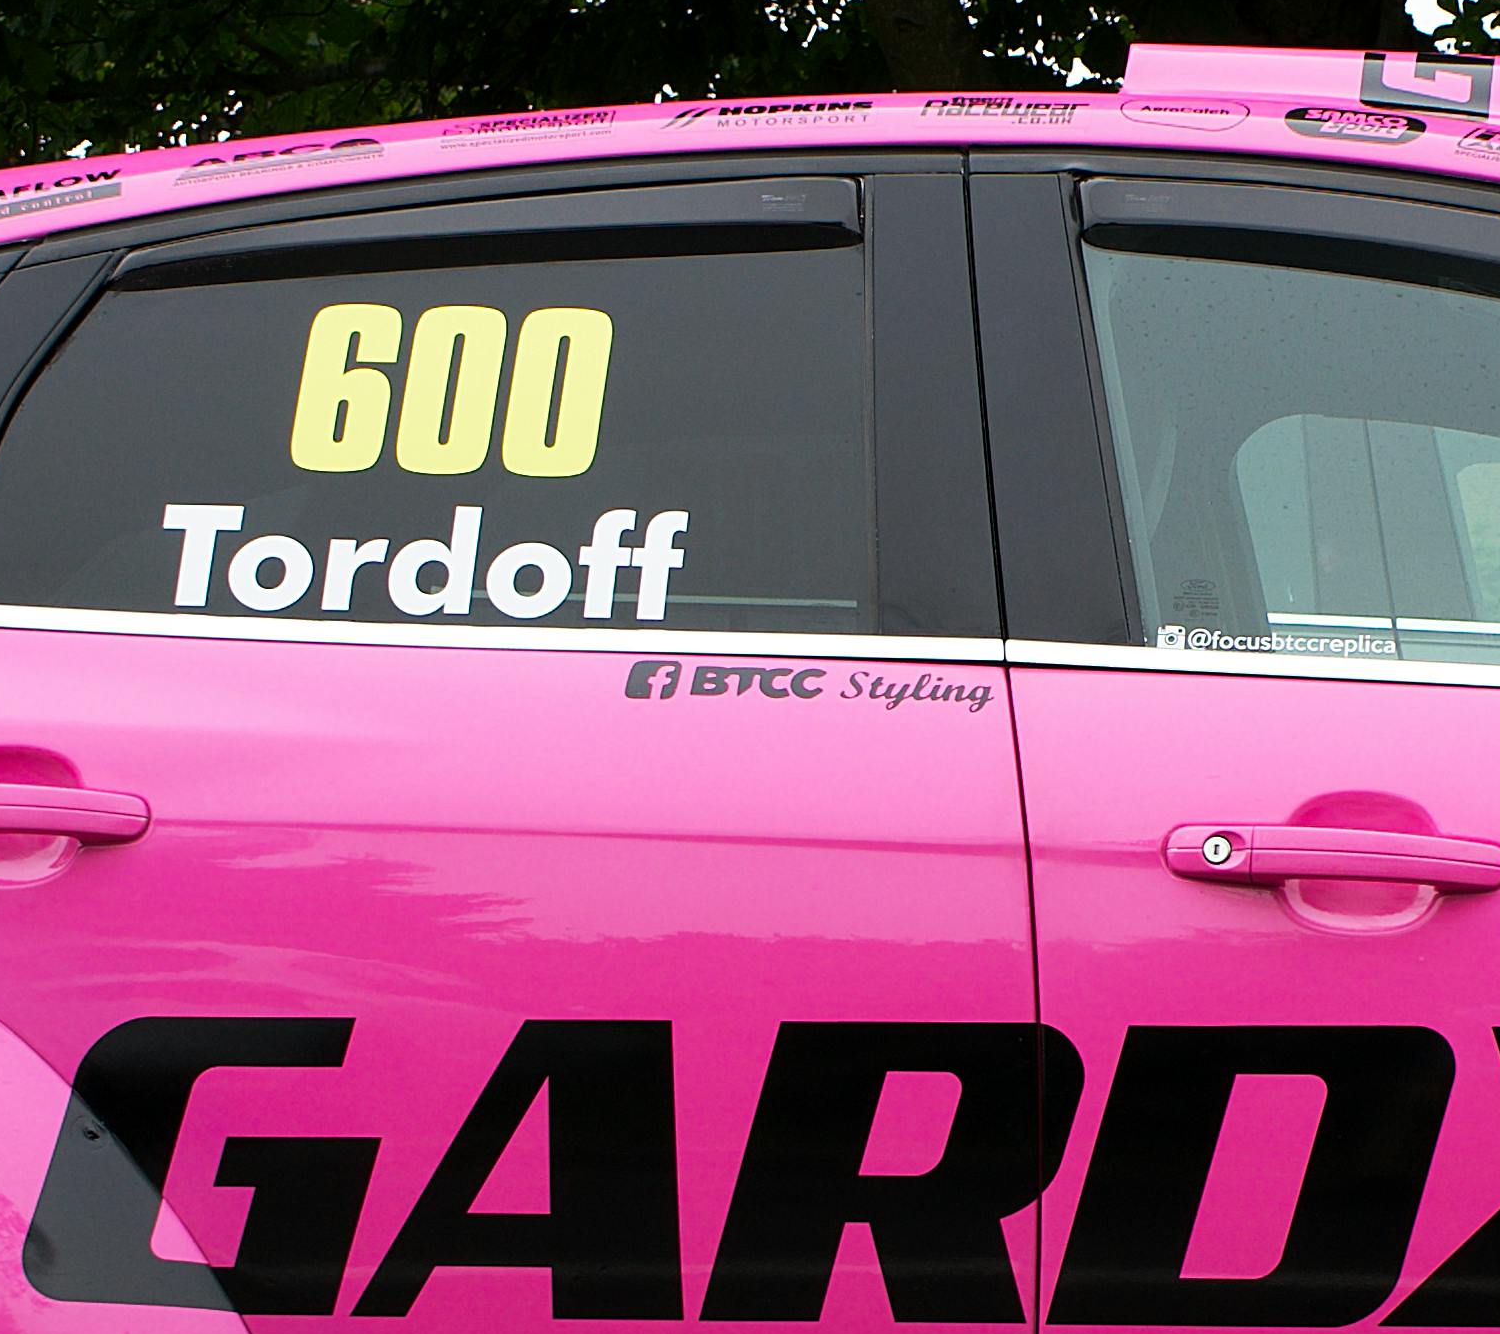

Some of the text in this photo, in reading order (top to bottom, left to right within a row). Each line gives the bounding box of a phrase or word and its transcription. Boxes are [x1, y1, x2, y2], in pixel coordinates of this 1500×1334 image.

[717, 115, 869, 128] MOTORSPORT
[718, 101, 873, 116] HOPKINS
[21, 191, 94, 212] control
[290, 303, 614, 478] 600
[161, 503, 690, 621] Tordoff
[1187, 628, 1396, 657] @focusbtccreplica
[690, 667, 825, 700] BTCC
[840, 670, 995, 712] Styling
